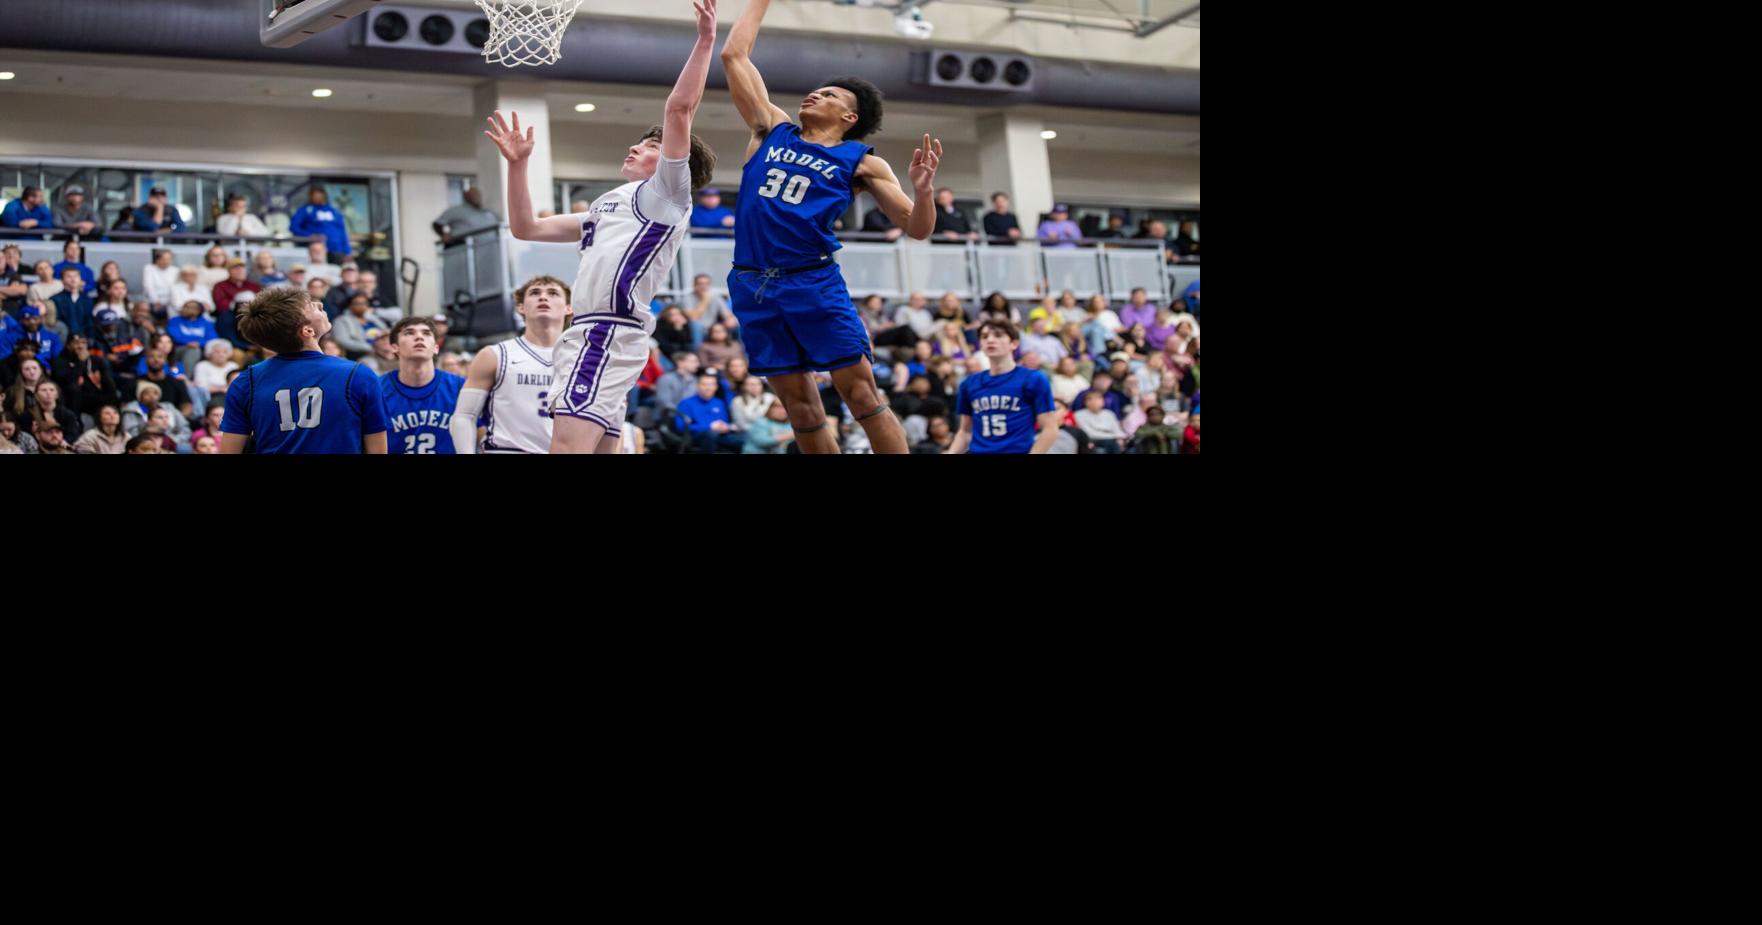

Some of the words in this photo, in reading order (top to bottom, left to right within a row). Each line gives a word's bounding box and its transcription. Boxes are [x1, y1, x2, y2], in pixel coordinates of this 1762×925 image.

[764, 146, 839, 180] MODEL
[758, 168, 811, 205] 30
[275, 387, 323, 432] 10
[971, 395, 1021, 414] MODEL
[981, 414, 1008, 437] 15
